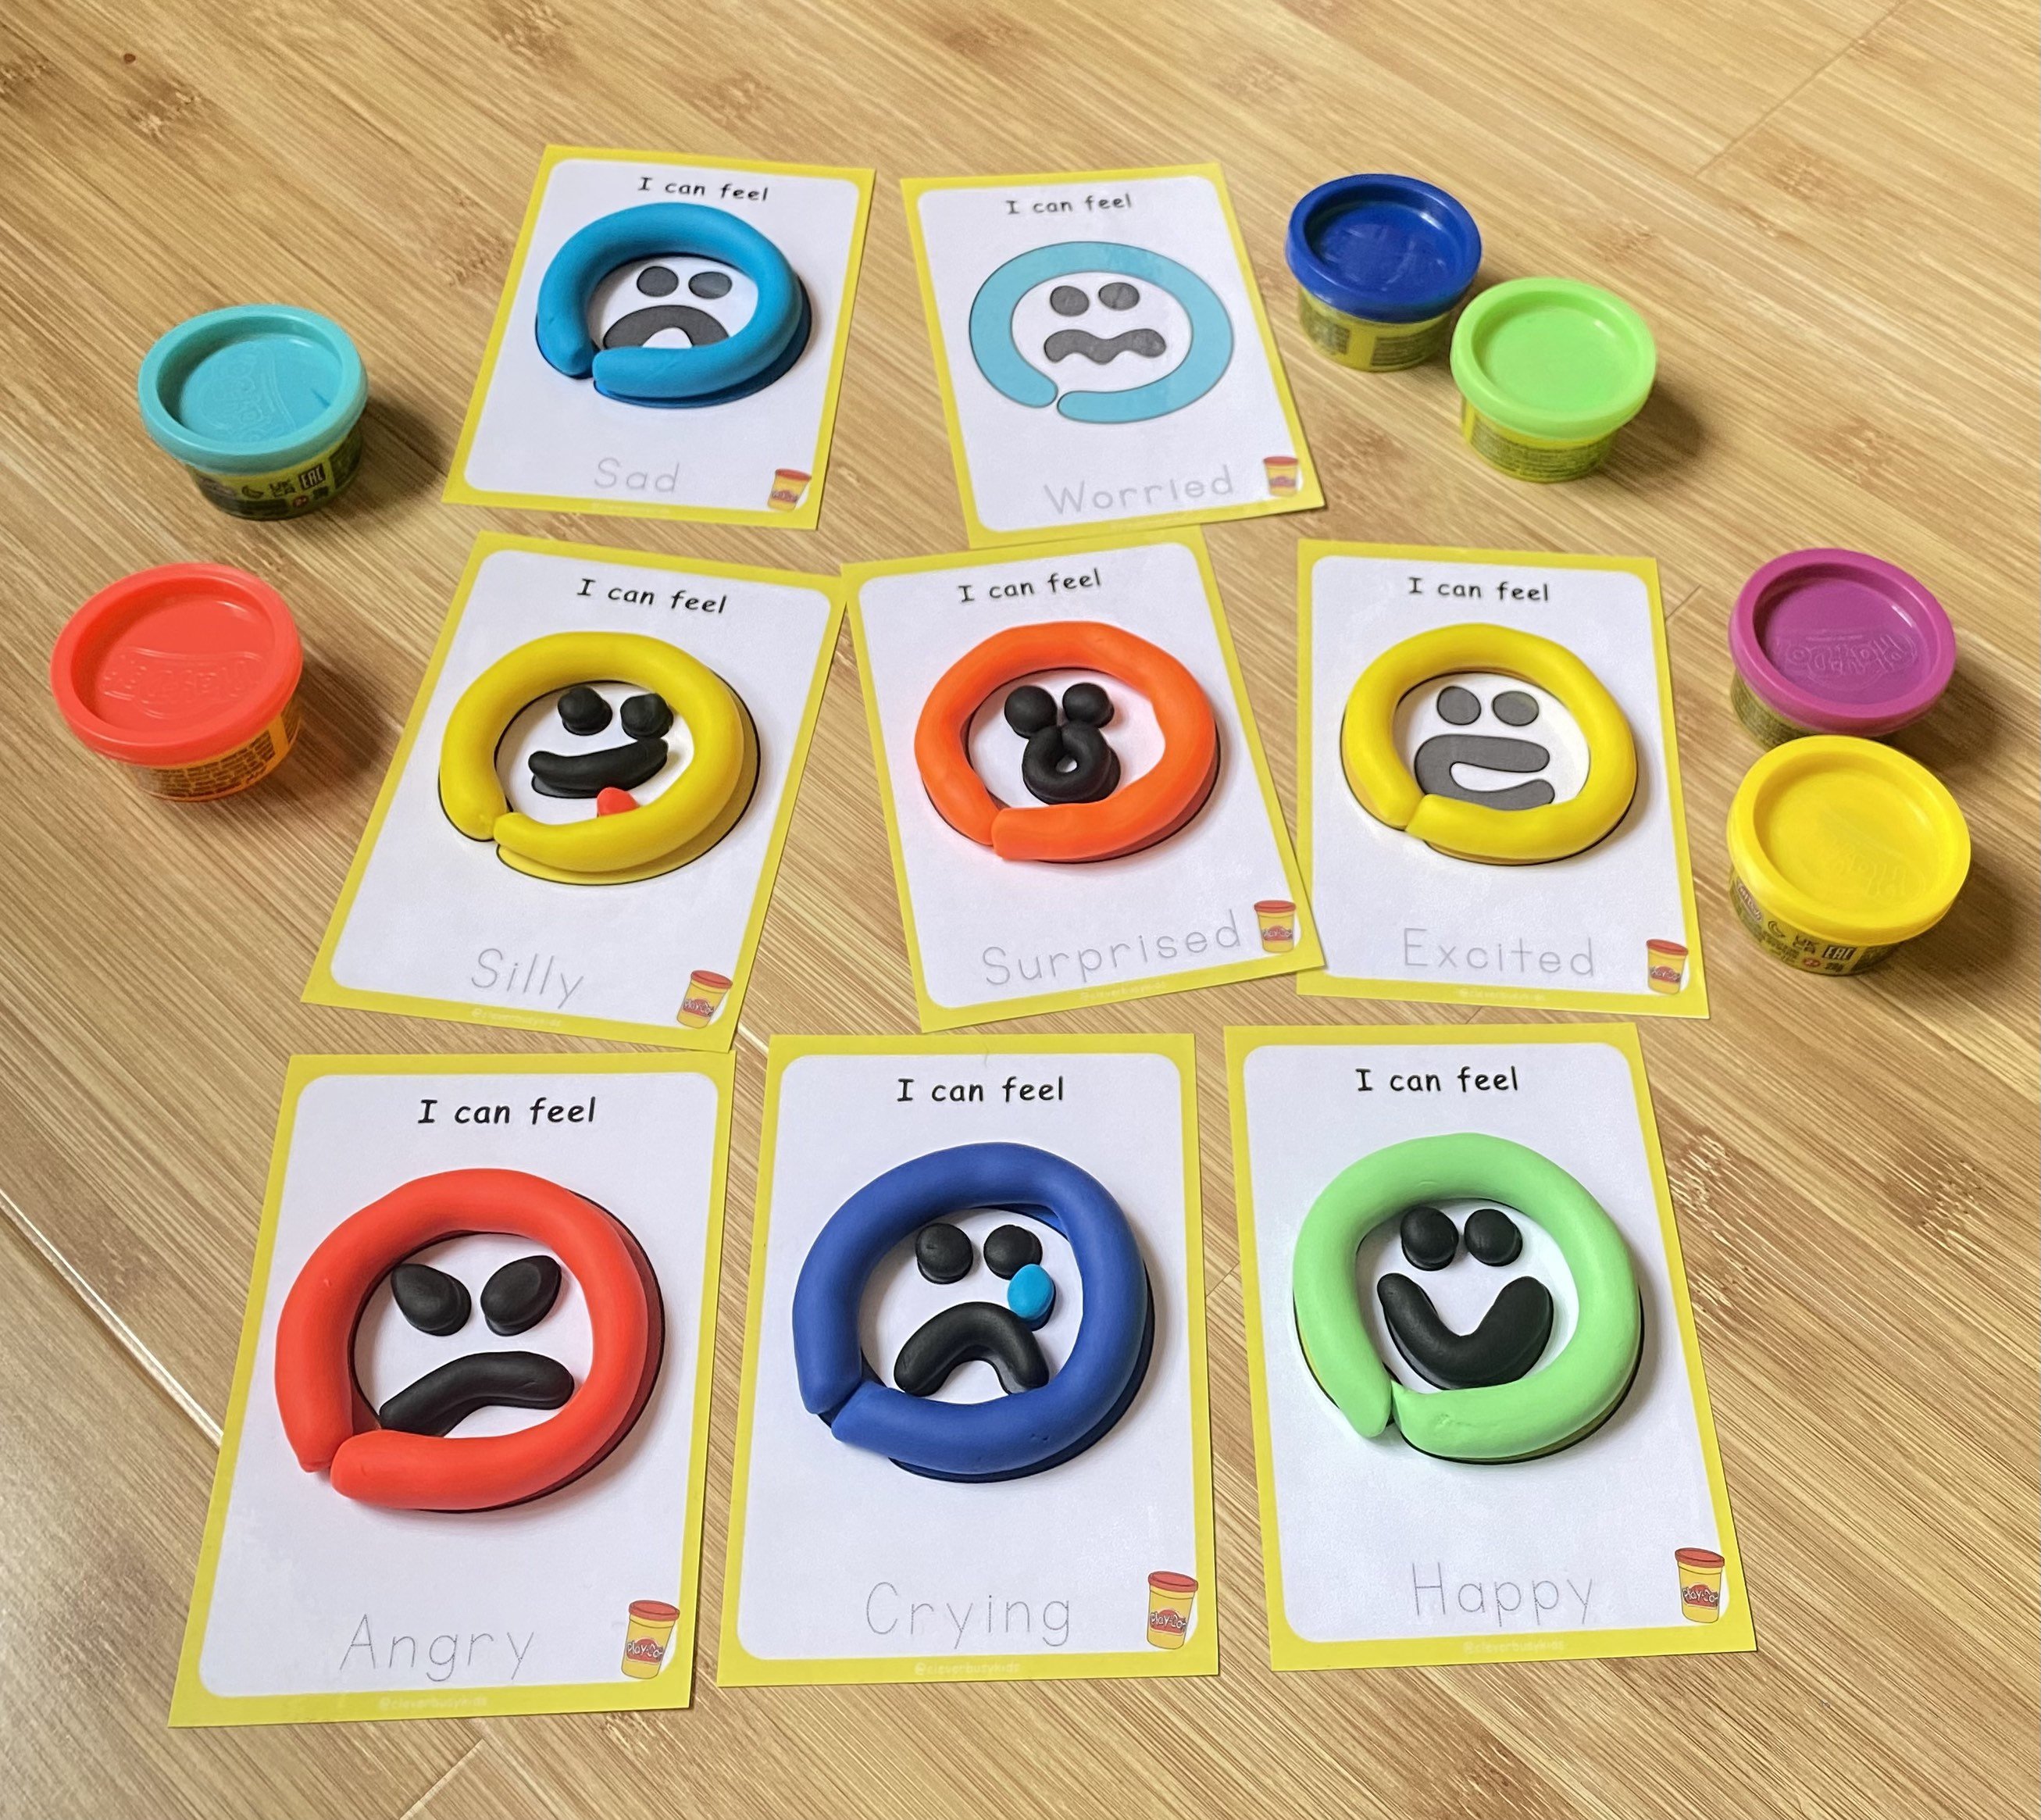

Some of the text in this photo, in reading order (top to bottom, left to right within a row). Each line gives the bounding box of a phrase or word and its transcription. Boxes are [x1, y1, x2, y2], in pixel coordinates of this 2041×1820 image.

[637, 176, 769, 202] I can feel
[1005, 193, 1132, 215] I can feel
[594, 457, 680, 494] Sad
[1043, 464, 1234, 515] Worried
[576, 577, 728, 615] I can feel
[958, 567, 1101, 604] I can feel
[1408, 576, 1549, 602] I can feel
[982, 908, 1241, 987] Surprised
[1403, 927, 1595, 978] Excited
[470, 947, 584, 1010] Silly
[896, 1075, 1064, 1104] I can feel
[1354, 1065, 1518, 1094] I can feel
[417, 1095, 596, 1126] I can feel
[1411, 1561, 1595, 1628] Happy
[865, 1581, 1070, 1650] Crying
[339, 1613, 534, 1683] Angry
